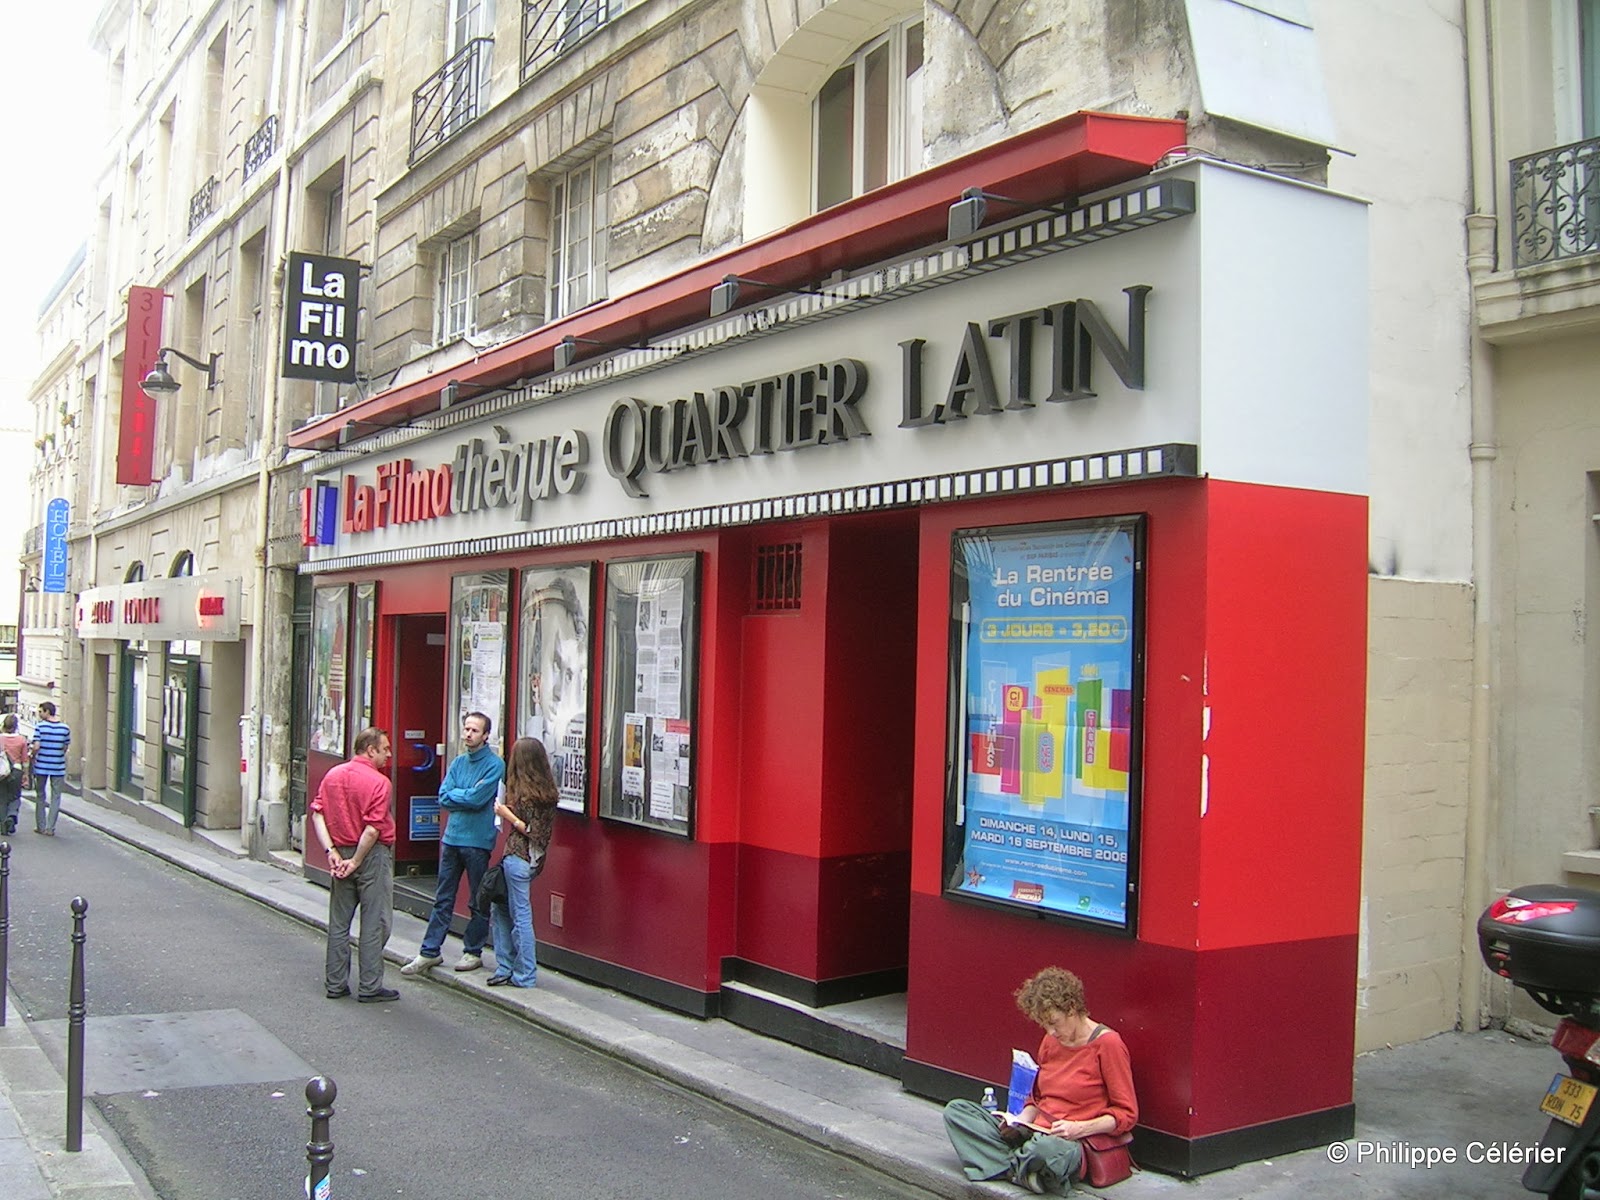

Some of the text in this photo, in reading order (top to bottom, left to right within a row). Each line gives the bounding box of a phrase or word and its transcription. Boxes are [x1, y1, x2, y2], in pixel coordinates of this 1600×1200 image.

[302, 261, 346, 299] La
[299, 302, 345, 338] Fil
[290, 339, 350, 370] mo
[343, 285, 1154, 533] La Filmothèque QUARTIER LATIN
[996, 562, 1114, 585] La Rentrée
[998, 587, 1110, 607] du Cinéma
[987, 623, 998, 637] 3
[1002, 623, 1054, 638] JOURS
[971, 830, 1128, 863] MARDI 16 SEPTEMBRE 2008
[979, 817, 1119, 848] DIMANCHE 14, LUNDI 15,
[1563, 1081, 1582, 1098] 333
[1570, 1103, 1583, 1119] 75
